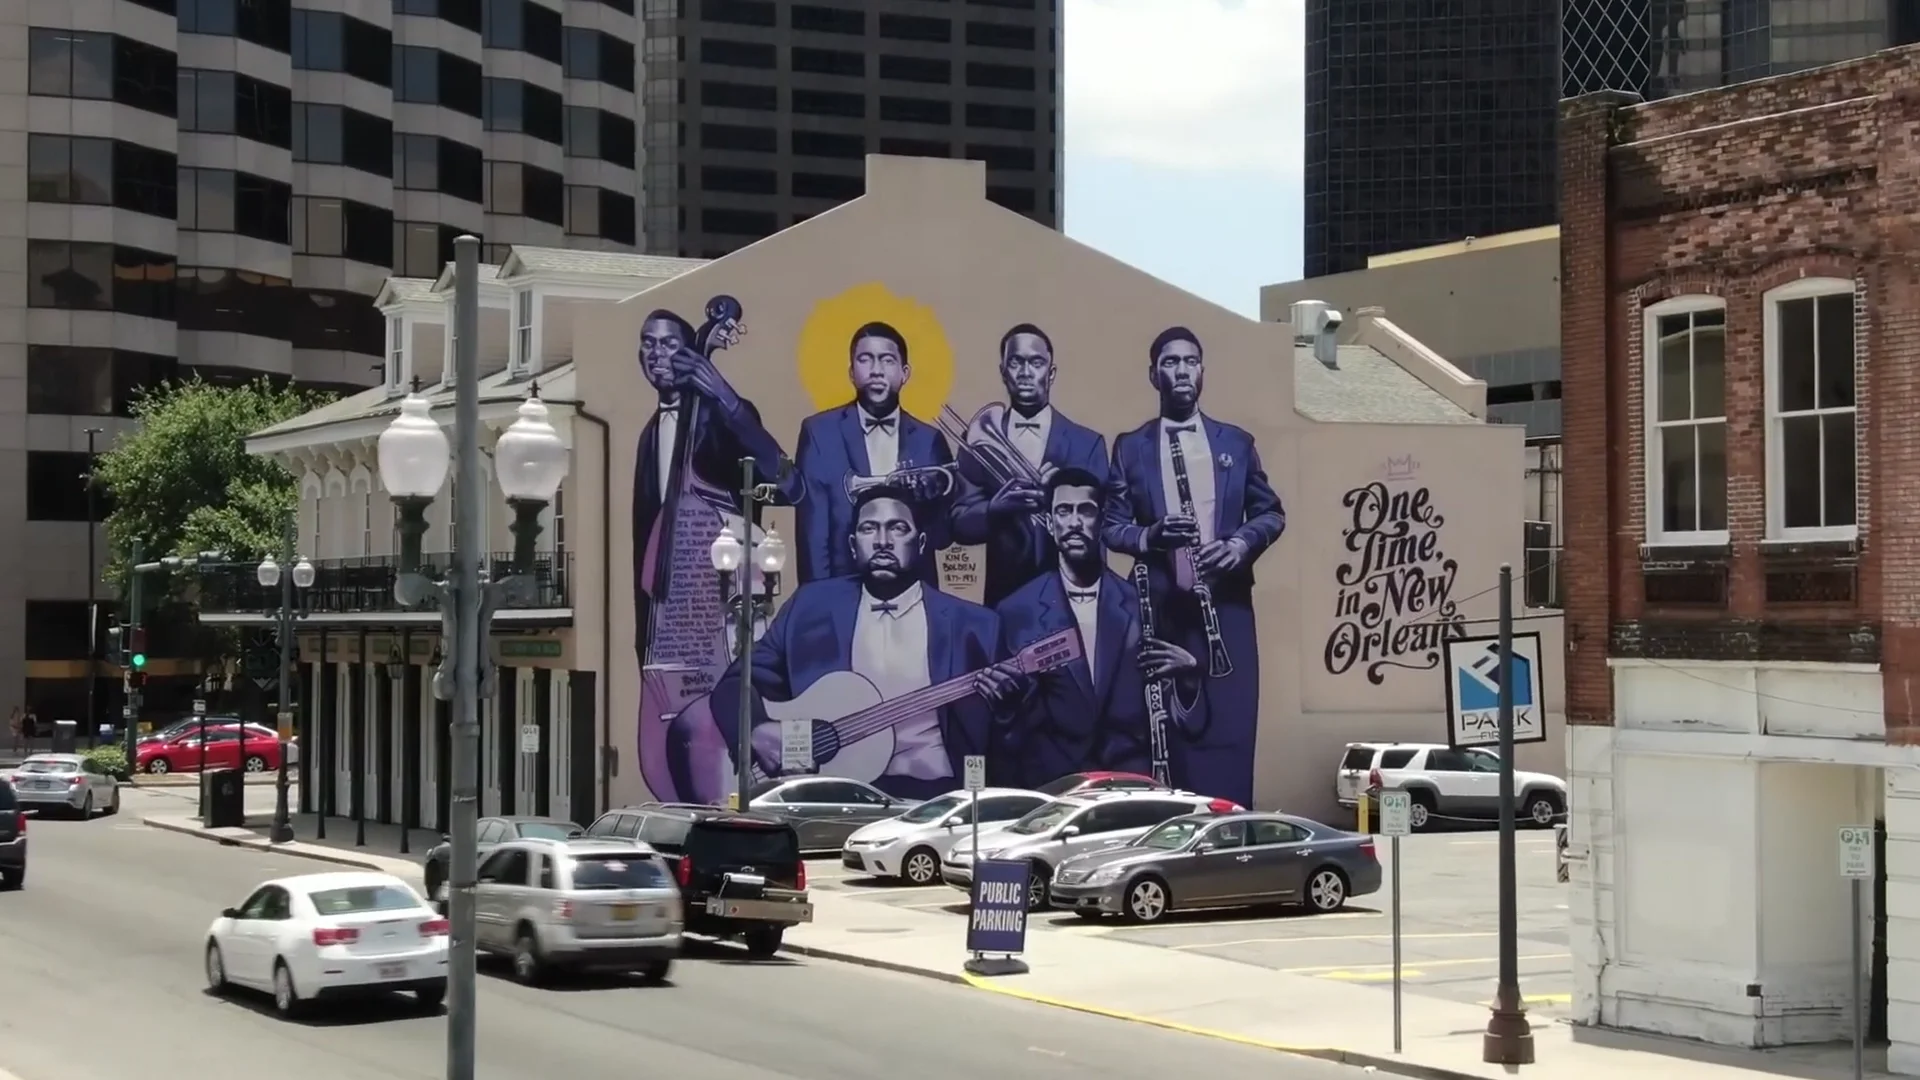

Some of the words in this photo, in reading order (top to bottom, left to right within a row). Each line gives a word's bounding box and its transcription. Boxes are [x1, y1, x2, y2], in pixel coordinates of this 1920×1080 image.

[1343, 482, 1444, 533] One
[942, 562, 976, 572] BOLDEN
[945, 553, 970, 562] KING
[1335, 588, 1361, 618] in
[1360, 559, 1458, 629] New
[1461, 707, 1533, 731] PAK
[979, 881, 1021, 905] PUBLIC
[972, 908, 1023, 932] PARKING
